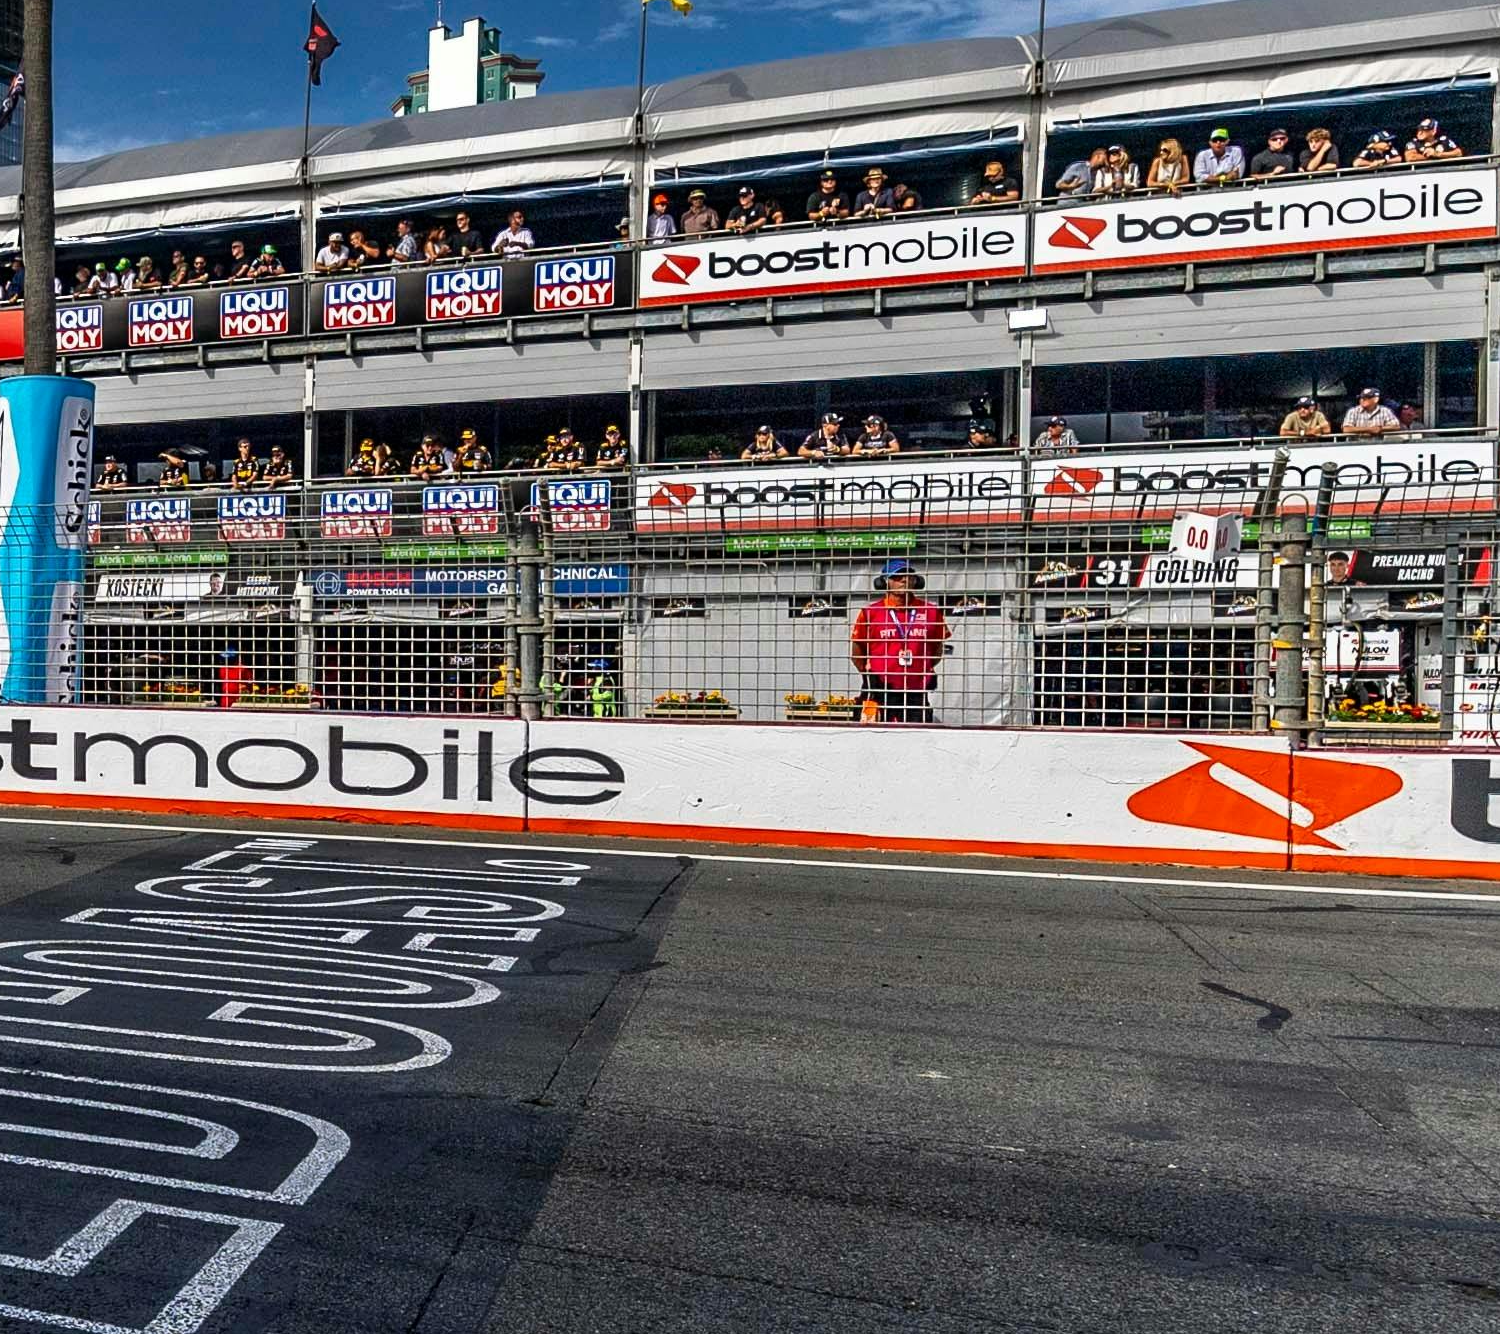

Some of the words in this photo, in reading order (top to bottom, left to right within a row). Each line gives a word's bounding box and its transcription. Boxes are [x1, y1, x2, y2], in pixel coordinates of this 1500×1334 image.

[1117, 183, 1483, 244] boostmobile
[709, 225, 1014, 279] boostmobile
[428, 270, 500, 299] LIQUI
[538, 259, 613, 289] LIQUI
[222, 291, 287, 315] LIQUI
[326, 280, 394, 306] LIQUI
[536, 280, 614, 311] MOLY
[130, 300, 191, 324] LIQUI
[325, 302, 395, 329] MOLY
[427, 291, 502, 321] MOLY
[56, 308, 101, 331] IQUI
[222, 311, 288, 337] MOLY
[130, 322, 192, 346] MOLY
[65, 415, 92, 534] Schick
[324, 491, 390, 514] LIQUI
[427, 487, 497, 510] LIQUI
[546, 482, 608, 506] IQUI
[129, 501, 190, 521] LIQUI
[221, 496, 284, 518] LIQUI
[1186, 526, 1208, 551] 0.0
[1095, 560, 1133, 586] 31
[1155, 558, 1240, 584] GOLDING
[1372, 553, 1424, 568] PREMIAIR
[425, 570, 510, 582] MOTORSPO
[548, 567, 618, 580] CHNICAL
[1397, 567, 1434, 581] RACING
[106, 577, 165, 598] KOSTECKI
[346, 588, 378, 596] POWER
[380, 588, 411, 596] TOOLS
